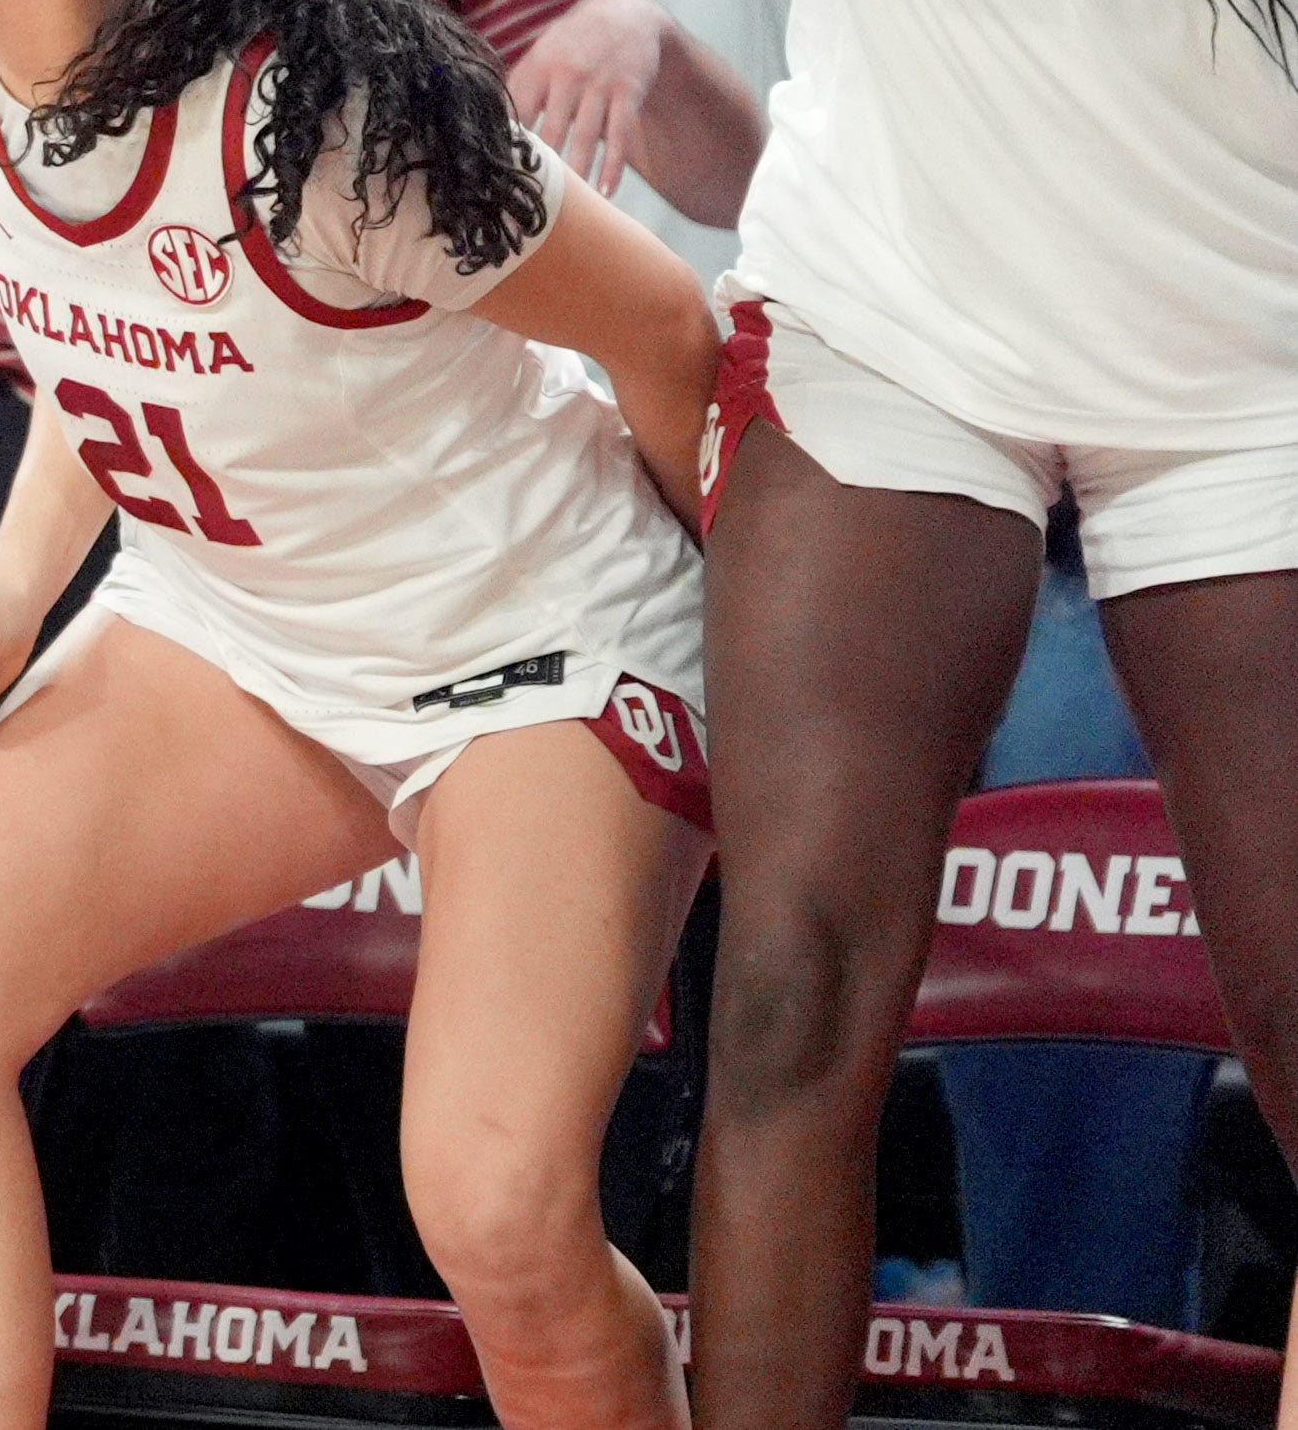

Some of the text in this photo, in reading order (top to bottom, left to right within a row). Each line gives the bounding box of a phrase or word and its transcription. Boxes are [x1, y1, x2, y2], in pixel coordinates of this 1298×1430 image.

[149, 225, 231, 305] SEC
[54, 377, 263, 547] 21
[611, 682, 683, 772] OU
